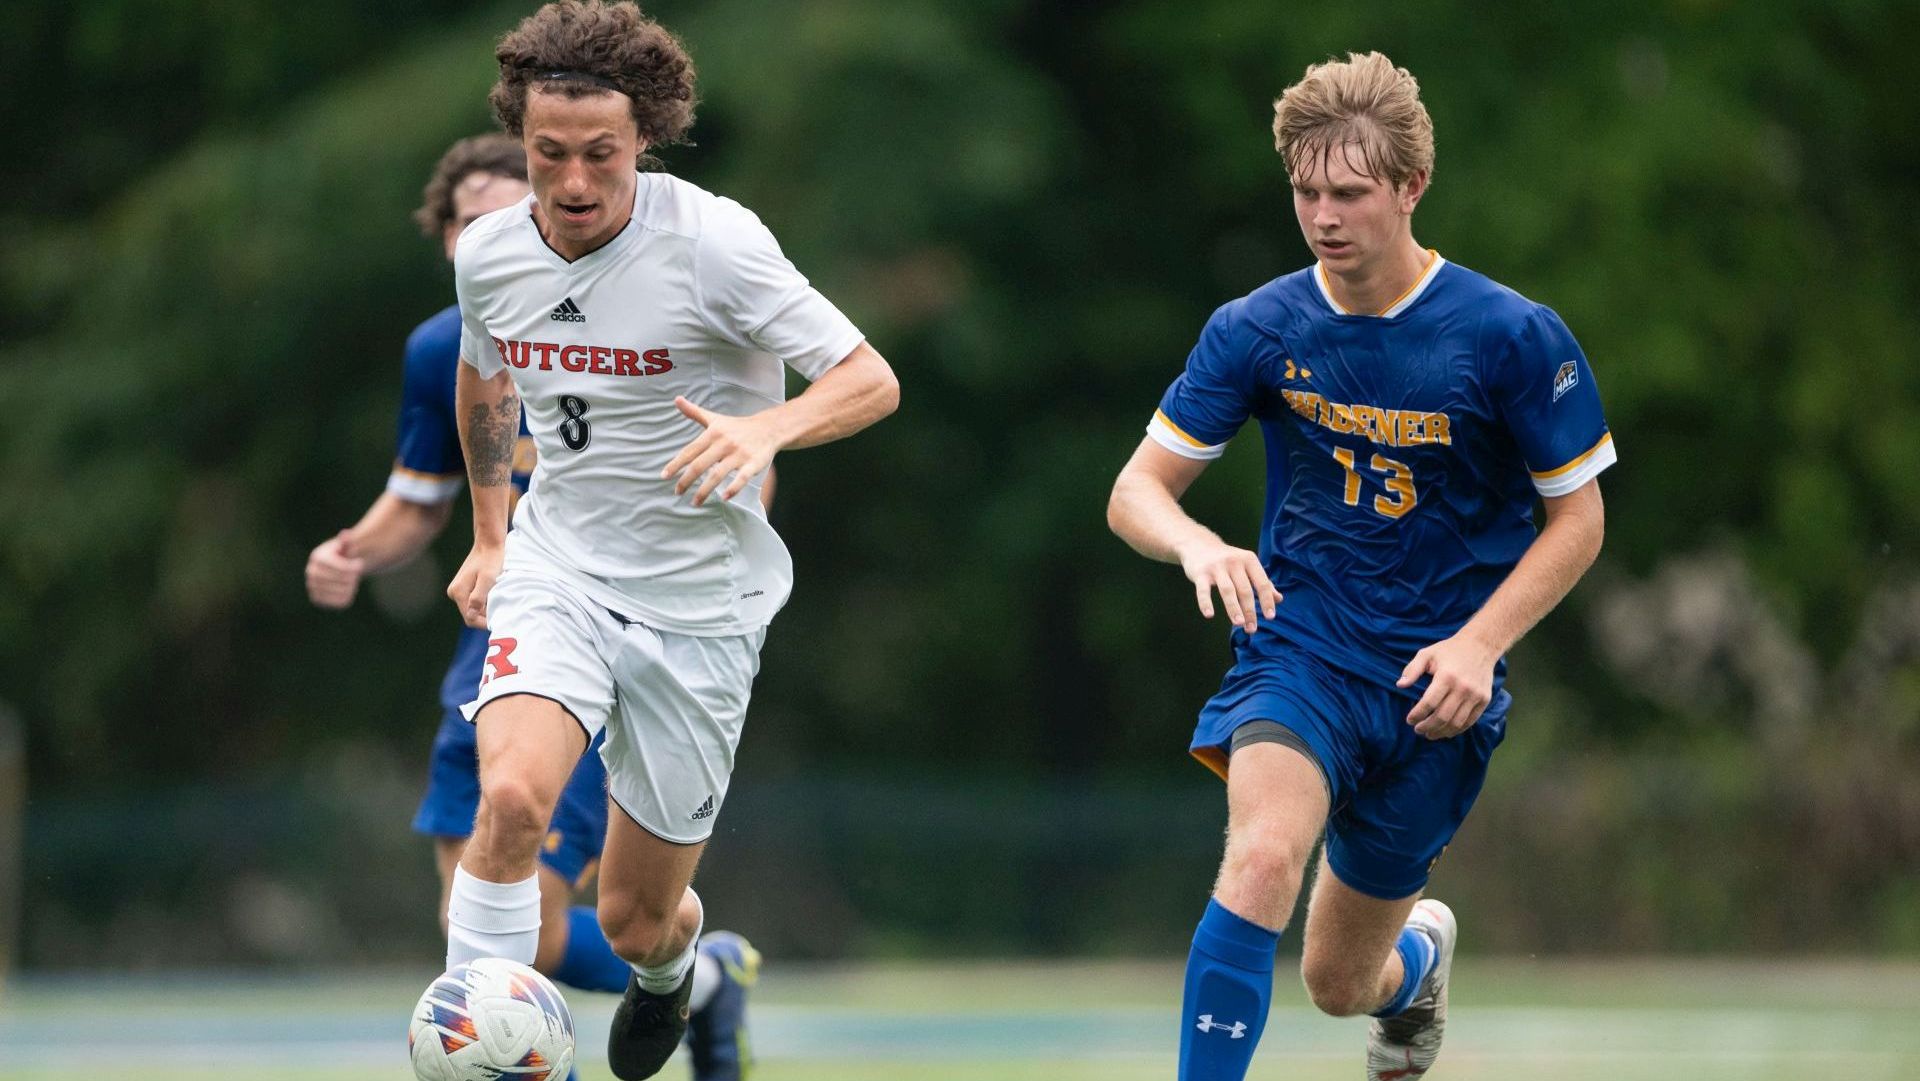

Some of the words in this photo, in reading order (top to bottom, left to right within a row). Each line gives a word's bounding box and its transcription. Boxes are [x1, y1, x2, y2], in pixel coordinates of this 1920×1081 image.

[550, 311, 586, 322] adidas
[1555, 371, 1576, 397] MAC
[557, 395, 592, 452] 8
[1281, 388, 1452, 447] WIDENER
[1333, 446, 1418, 519] 13
